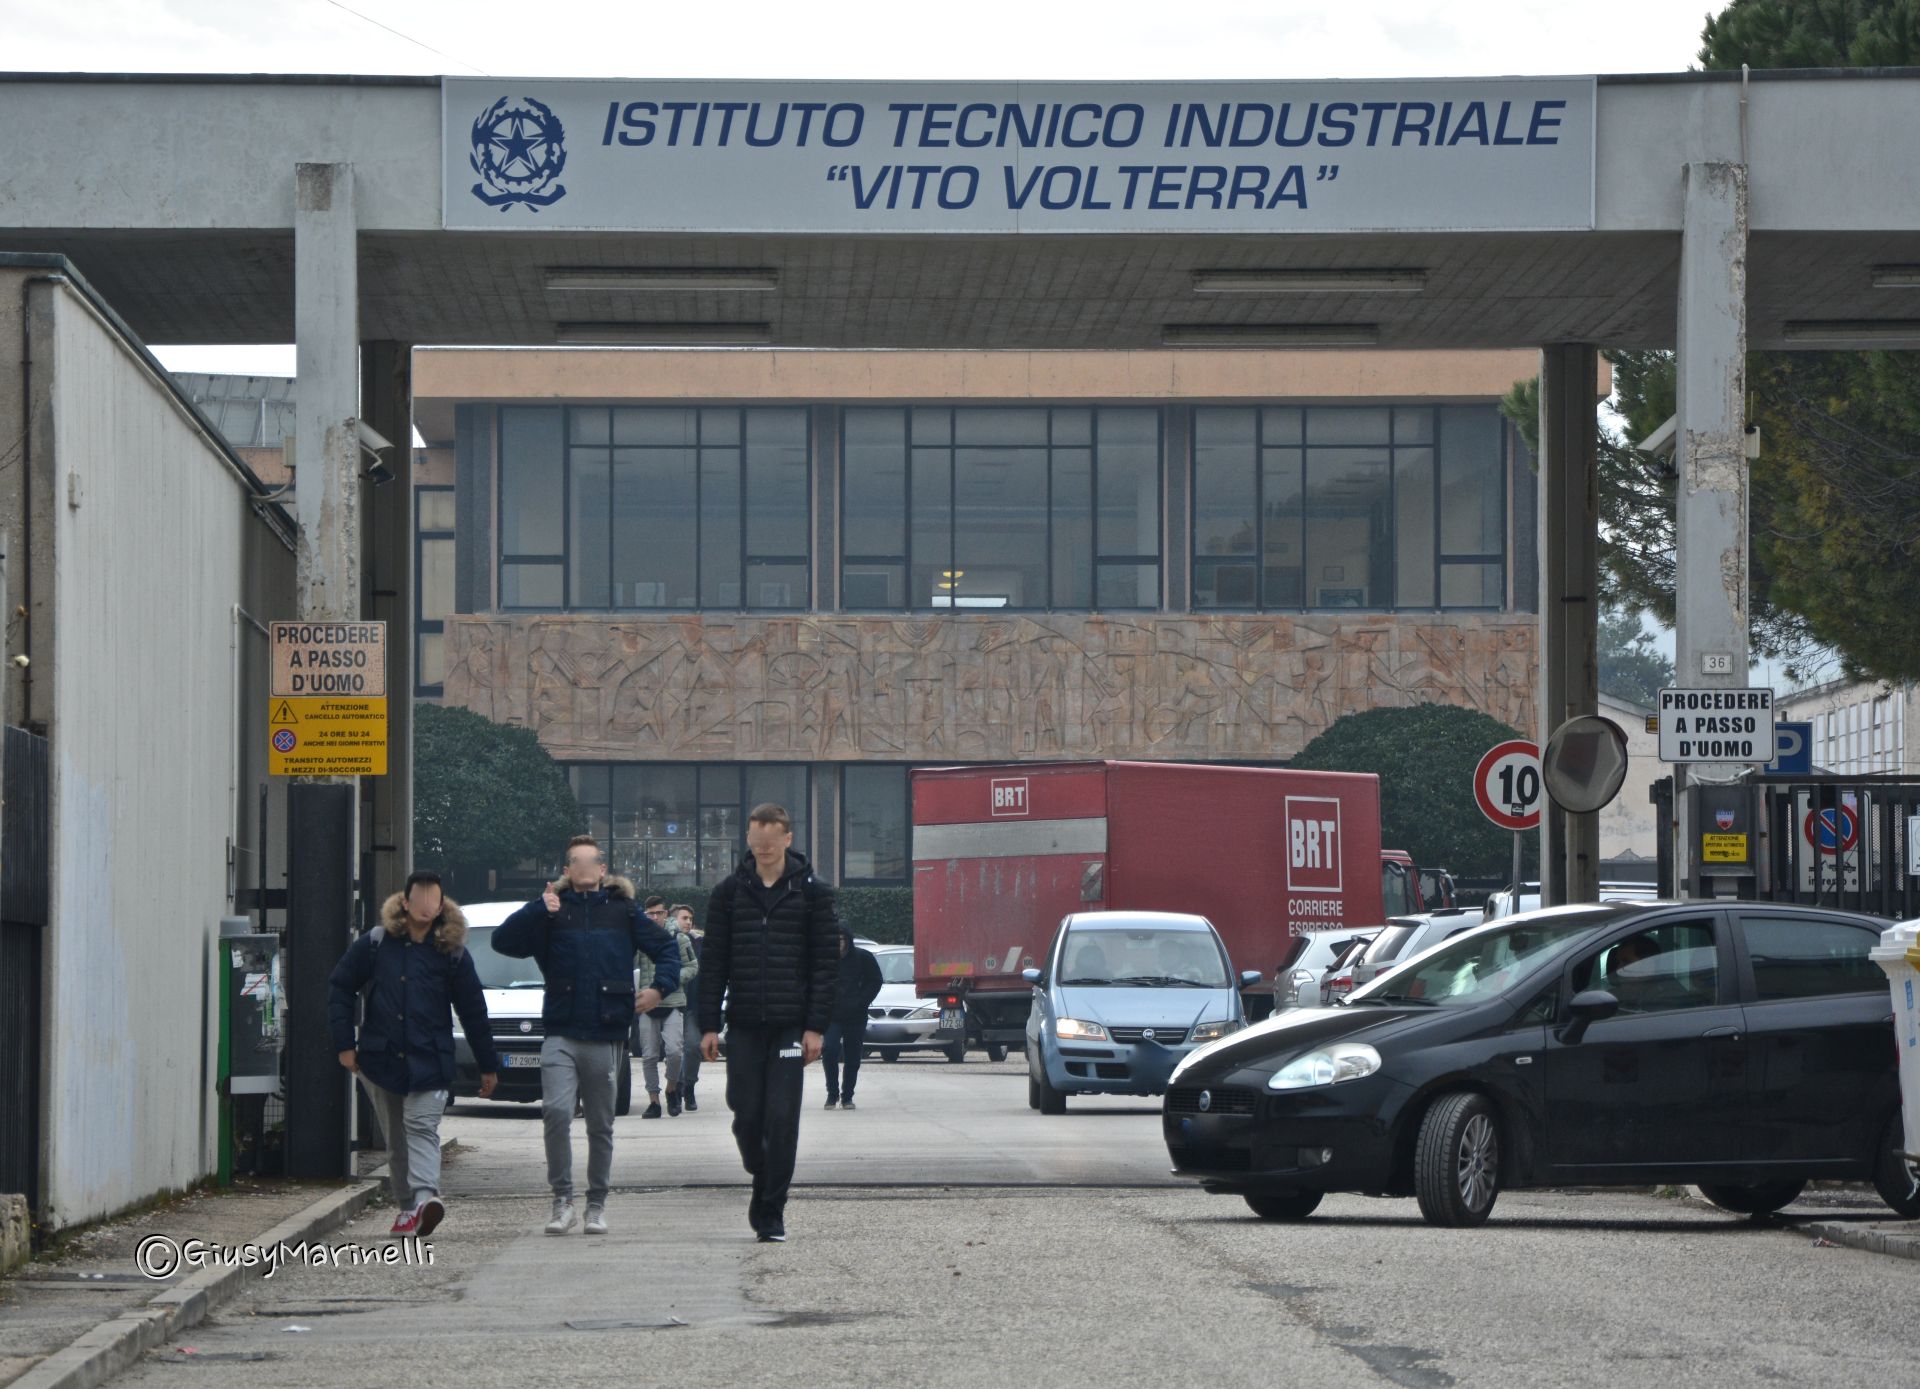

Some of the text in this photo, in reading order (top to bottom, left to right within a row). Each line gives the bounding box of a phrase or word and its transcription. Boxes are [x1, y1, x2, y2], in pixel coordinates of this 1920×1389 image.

[602, 101, 1566, 147] ISTITUTO TECNICO INDUSTRIALE
[277, 627, 379, 644] PROCEDERE
[290, 650, 367, 668] A PASSO
[1709, 657, 1725, 668] 36
[292, 674, 364, 691] D'UOMO
[1662, 693, 1769, 710] PROCEDERE
[1675, 717, 1756, 733] A PASSO
[1680, 740, 1753, 757] D'UOMO
[1769, 730, 1803, 770] P
[1499, 765, 1540, 805] 10
[994, 786, 1025, 807] BRT
[1291, 819, 1336, 869] BRT
[1288, 899, 1343, 916] CORRIERE
